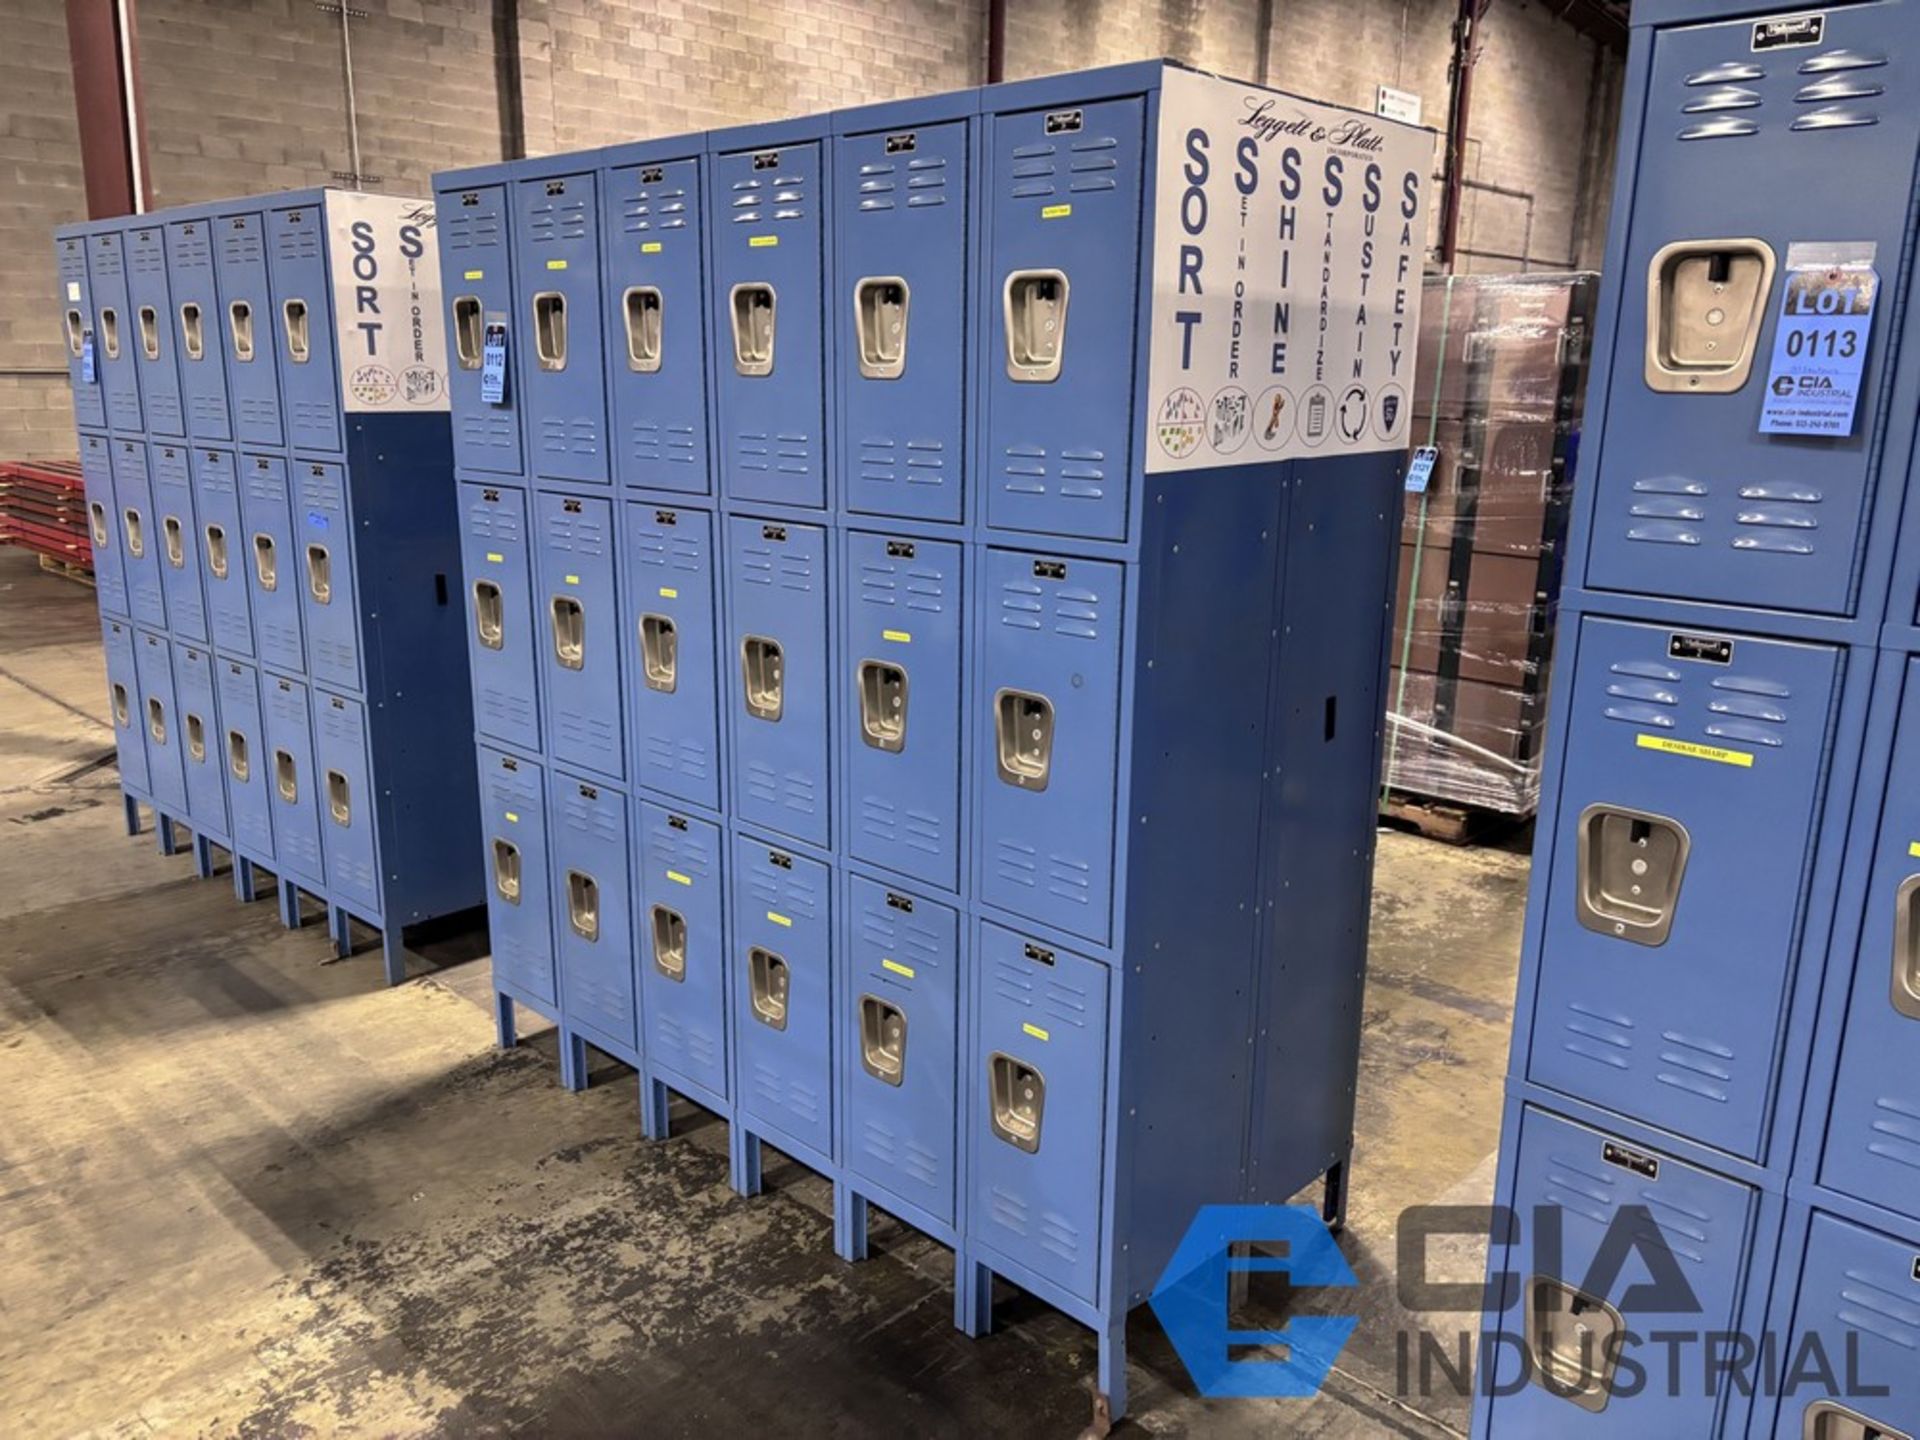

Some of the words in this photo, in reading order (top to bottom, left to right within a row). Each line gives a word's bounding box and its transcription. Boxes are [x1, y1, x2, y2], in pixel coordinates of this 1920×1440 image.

[1238, 96, 1312, 142] Leggett
[1310, 126, 1326, 142] &
[1234, 137, 1259, 227] SET
[351, 221, 382, 356] SORT
[1176, 128, 1210, 370] SORT
[1238, 238, 1246, 270] IN
[1271, 147, 1301, 374] SHINE
[1316, 155, 1344, 381] STANDARDIZE
[1353, 163, 1382, 378] SUSTAIN
[1390, 171, 1419, 377] SAFETY
[411, 306, 425, 362] ORDER
[1229, 281, 1245, 378] ORDER
[1787, 330, 1857, 357] 0113
[1797, 289, 1858, 314] LOT
[1796, 388, 1853, 398] INDUSTRIAL
[1798, 375, 1833, 388] CIA
